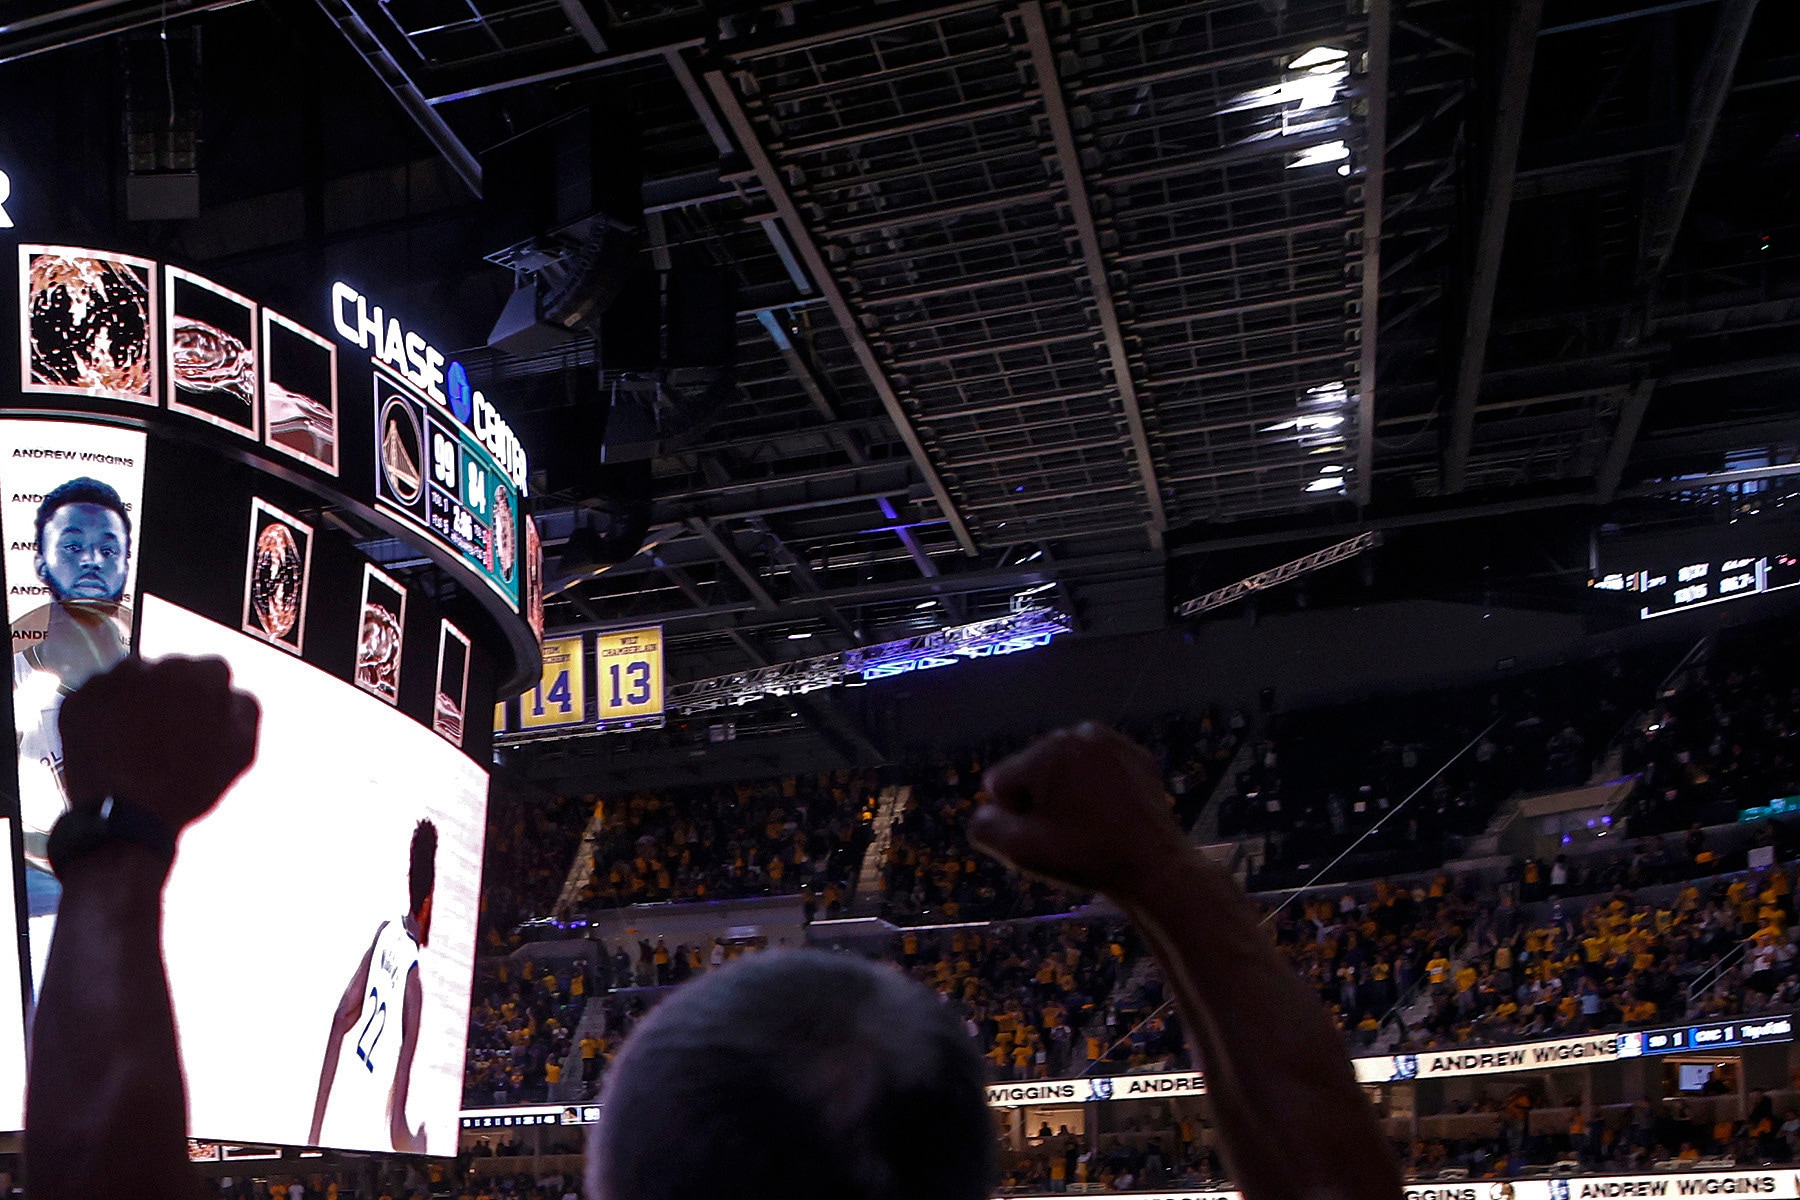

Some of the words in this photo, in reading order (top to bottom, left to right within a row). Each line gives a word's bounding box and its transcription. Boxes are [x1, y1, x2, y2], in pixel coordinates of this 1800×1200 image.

[332, 281, 447, 406] CHASE
[472, 390, 529, 498] CENTER
[12, 448, 76, 460] ANDREW
[80, 452, 135, 468] WIGGINS
[434, 433, 455, 488] 99
[467, 461, 487, 514] 84
[531, 669, 573, 718] 14
[609, 660, 652, 709] 13
[356, 986, 387, 1074] 22
[1429, 1050, 1528, 1072] ANDREW
[1532, 1038, 1618, 1063] WIGGINS
[986, 1084, 1075, 1101] WIGGINS
[1128, 1075, 1205, 1094] ANDRE
[1579, 1180, 1669, 1200] ANDREW
[1676, 1176, 1776, 1195] WIGGINS
